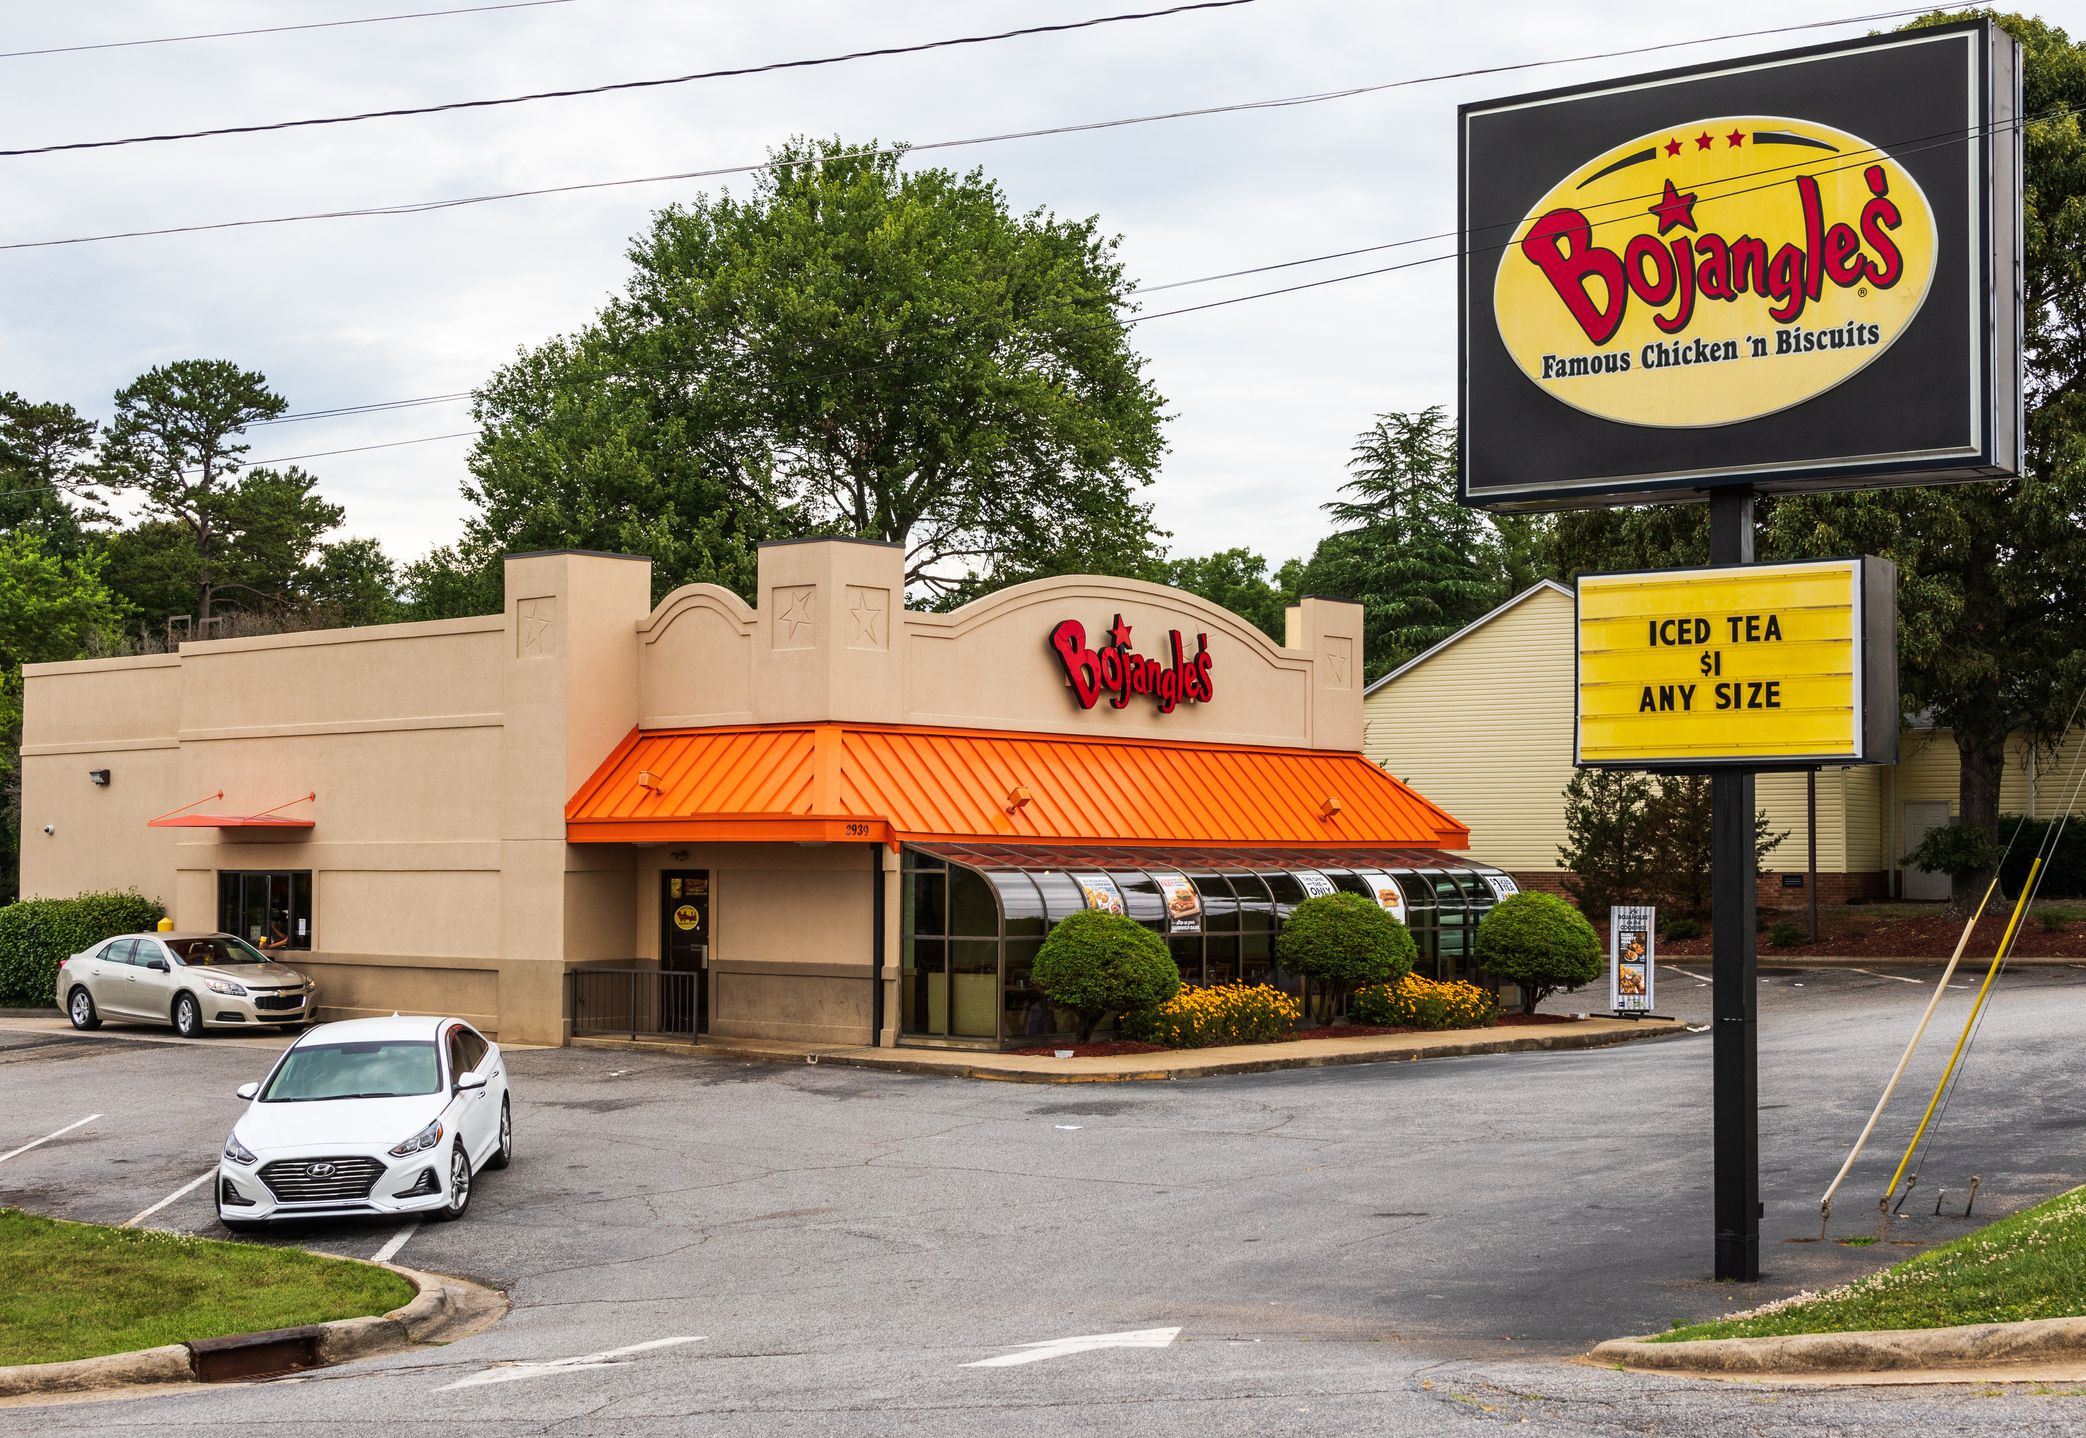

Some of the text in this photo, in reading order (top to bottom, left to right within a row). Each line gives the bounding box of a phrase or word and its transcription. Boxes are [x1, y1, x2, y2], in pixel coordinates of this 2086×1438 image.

[1542, 351, 1631, 380] Famous
[1641, 338, 1739, 370] Chicken
[1776, 320, 1880, 355] Biscuits
[1649, 614, 1782, 646] ICED TEA
[1700, 651, 1721, 676] $1
[1639, 681, 1781, 712] ANY SIZE
[846, 824, 869, 836] 2939
[1310, 887, 1331, 896] ONLY
